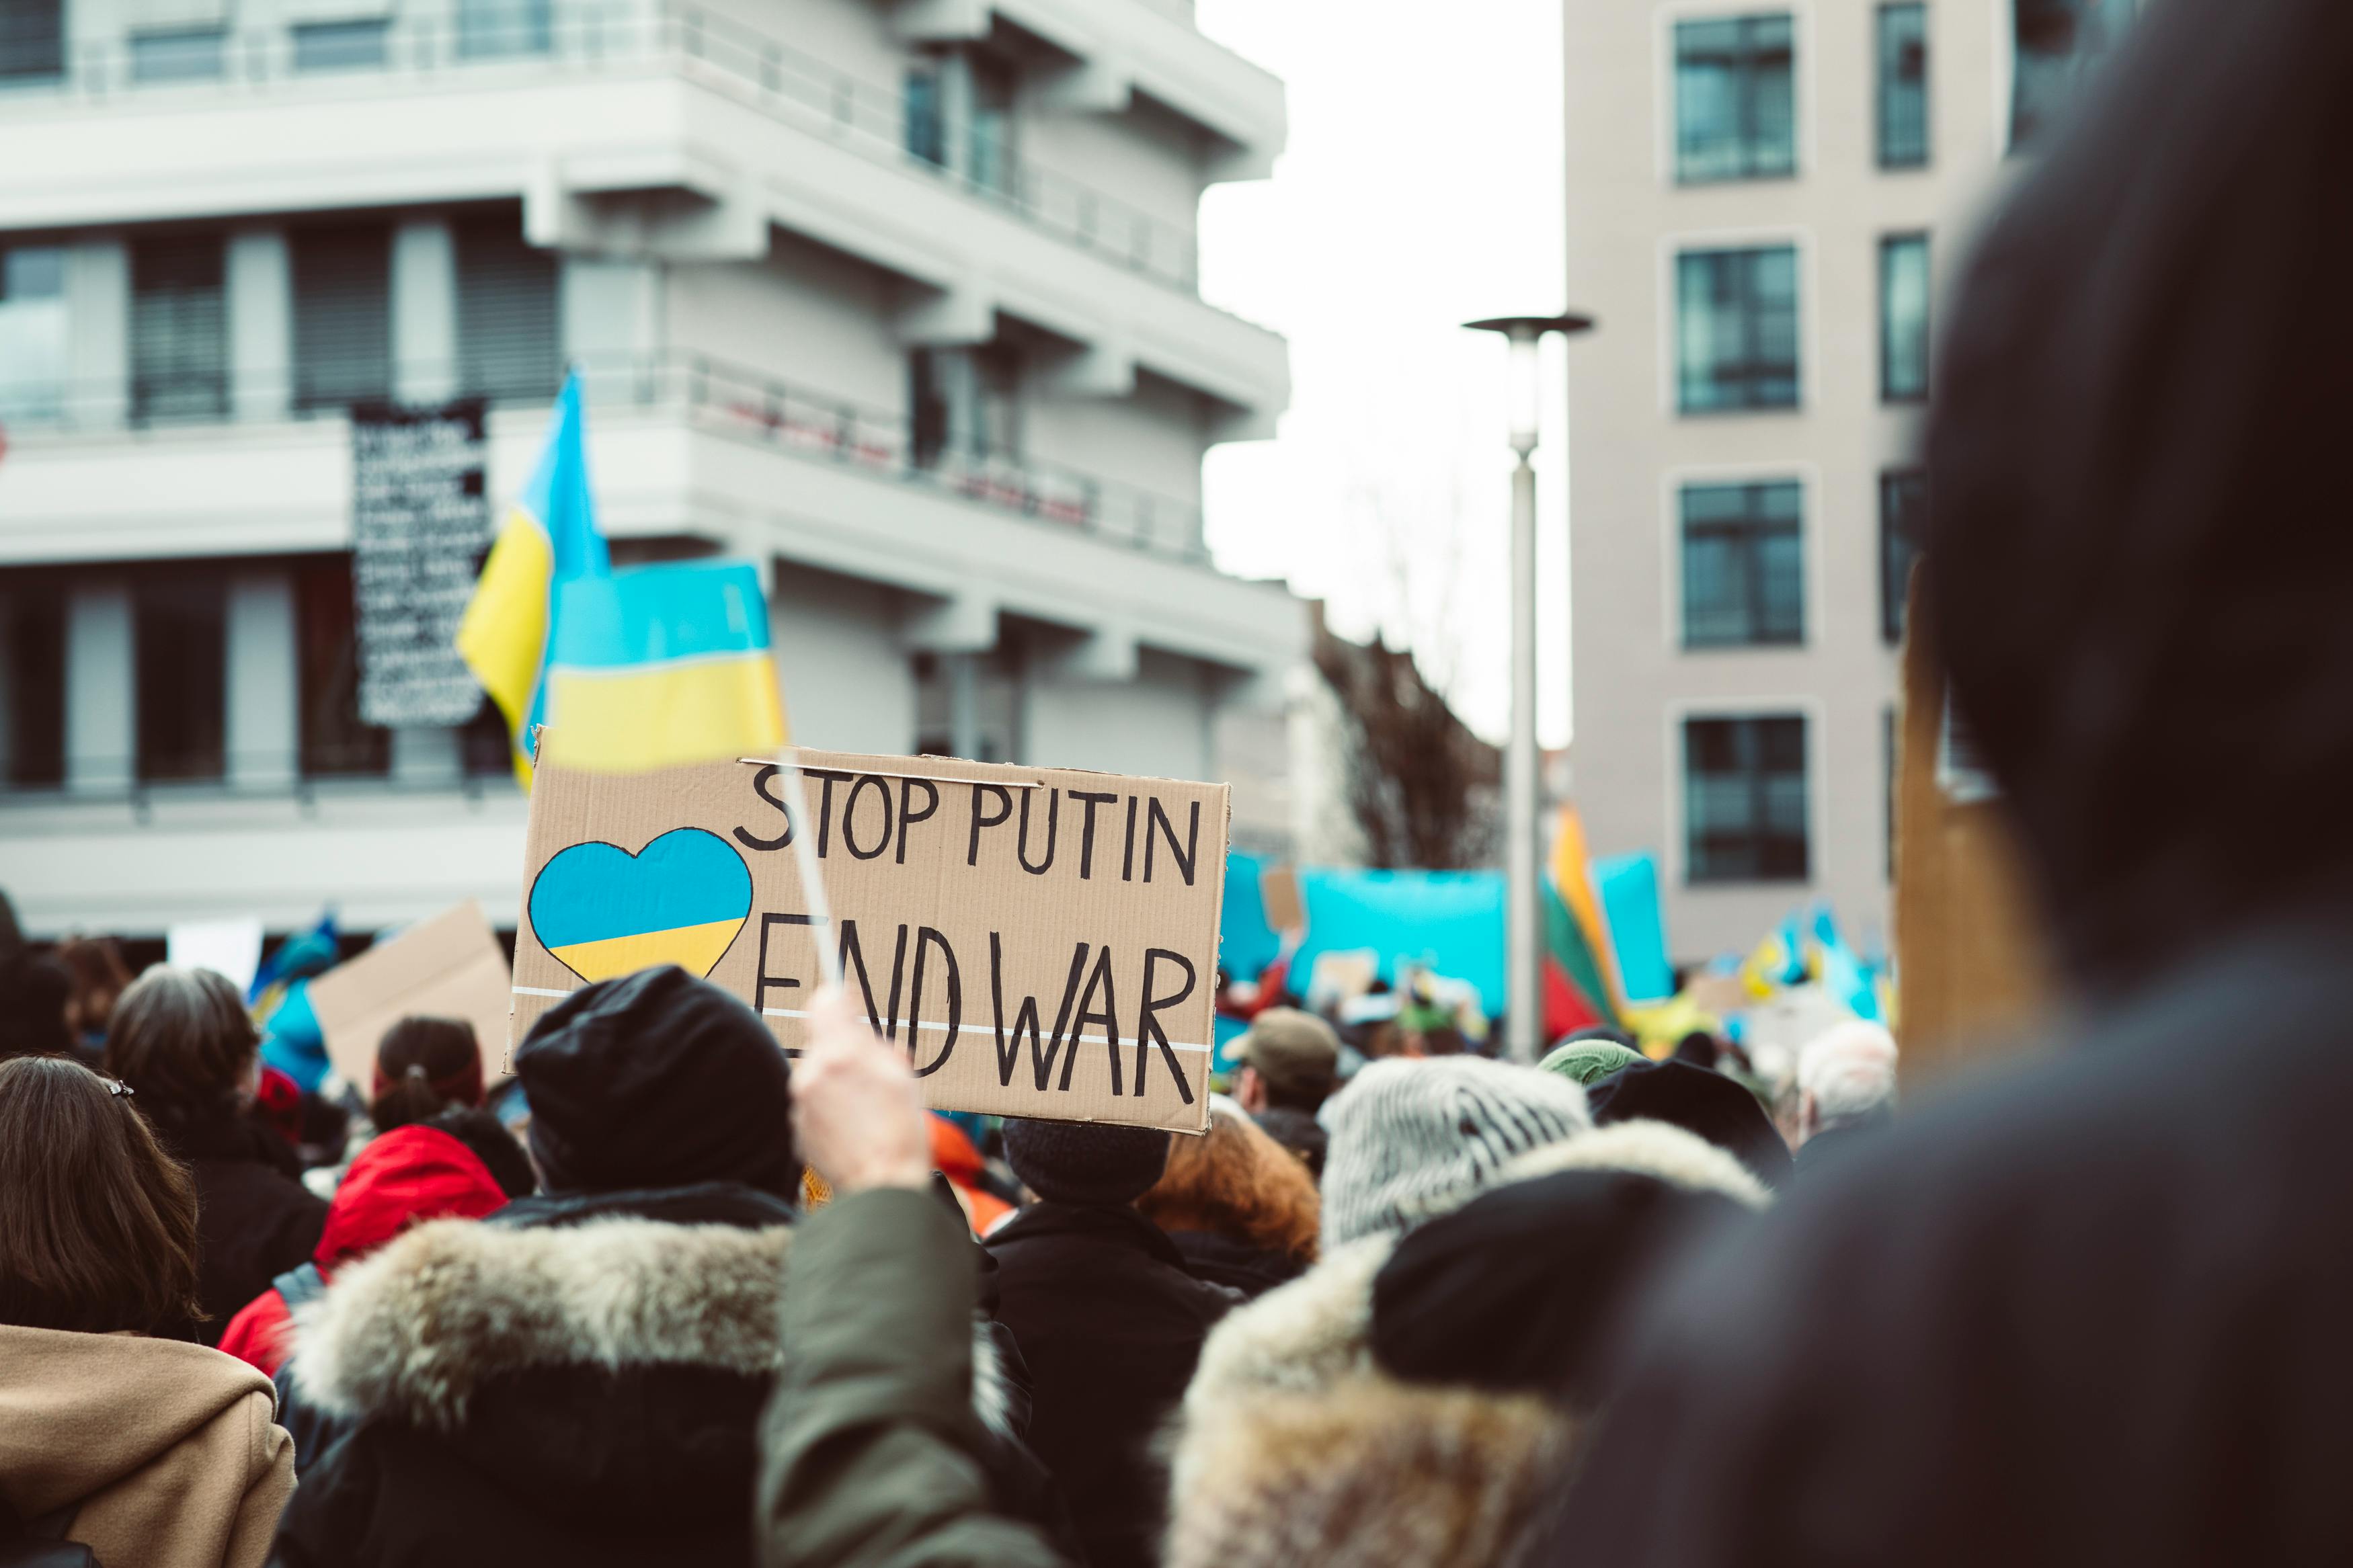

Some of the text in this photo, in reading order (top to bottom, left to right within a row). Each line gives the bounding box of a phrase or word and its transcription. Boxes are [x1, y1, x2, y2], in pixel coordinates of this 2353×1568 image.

[733, 764, 1200, 886] STOP PUTIN
[755, 912, 1195, 1104] END WAR
